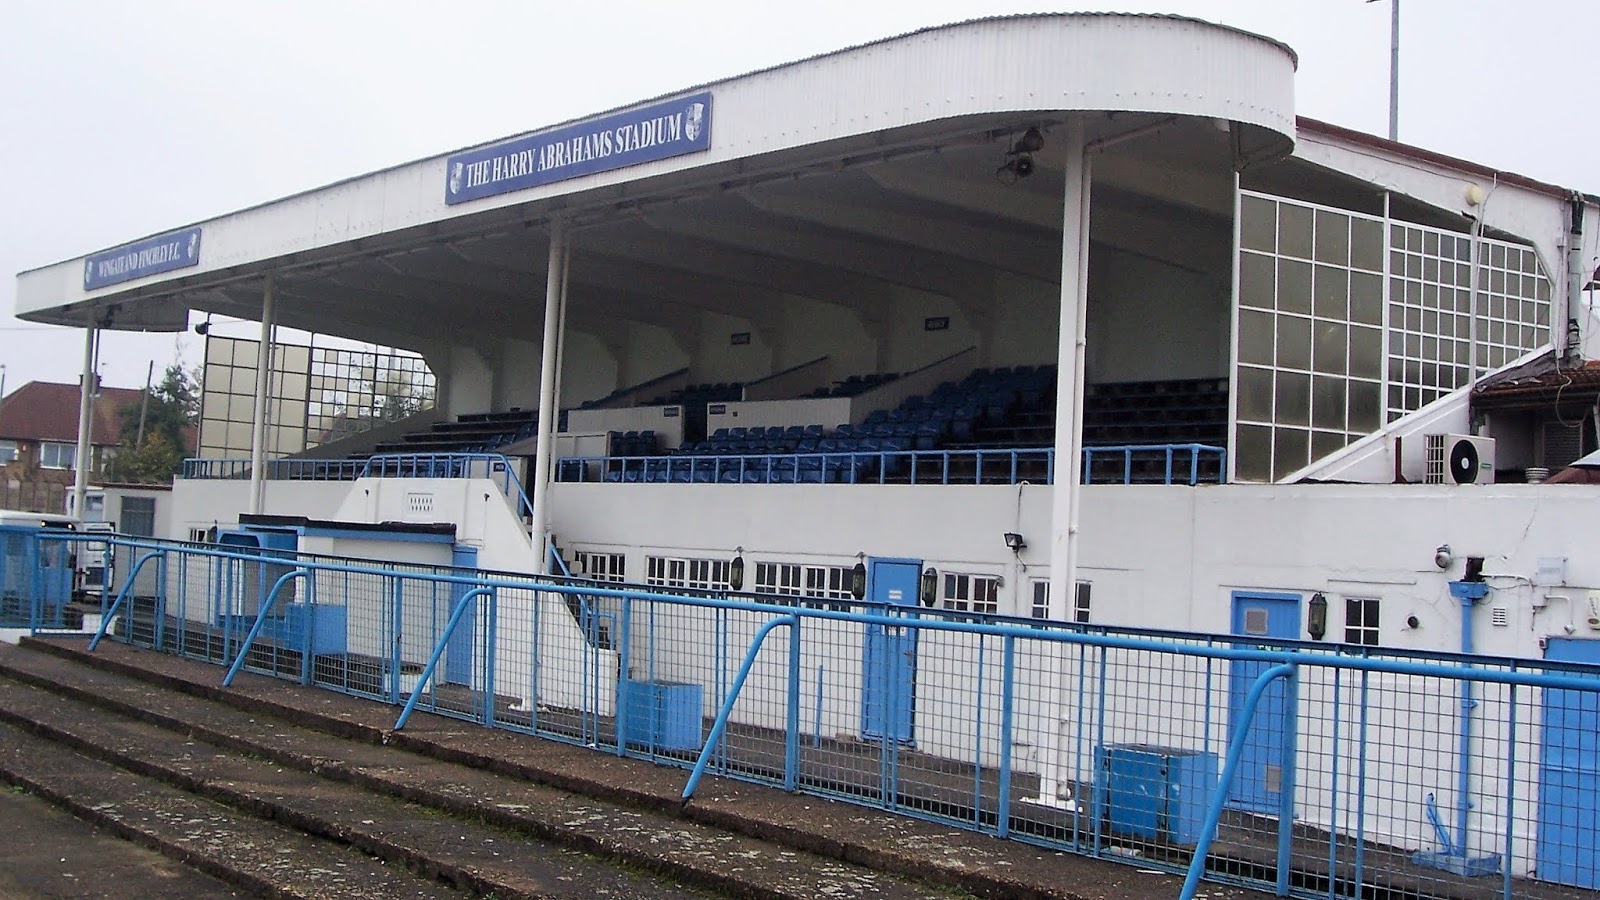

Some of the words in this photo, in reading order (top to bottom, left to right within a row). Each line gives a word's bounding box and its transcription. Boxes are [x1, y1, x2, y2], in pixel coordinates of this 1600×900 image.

[466, 160, 490, 188] THE
[491, 149, 536, 182] HARRY
[537, 130, 613, 172] ABRAHAMS
[615, 113, 682, 154] STADIUM
[125, 252, 139, 270] AND
